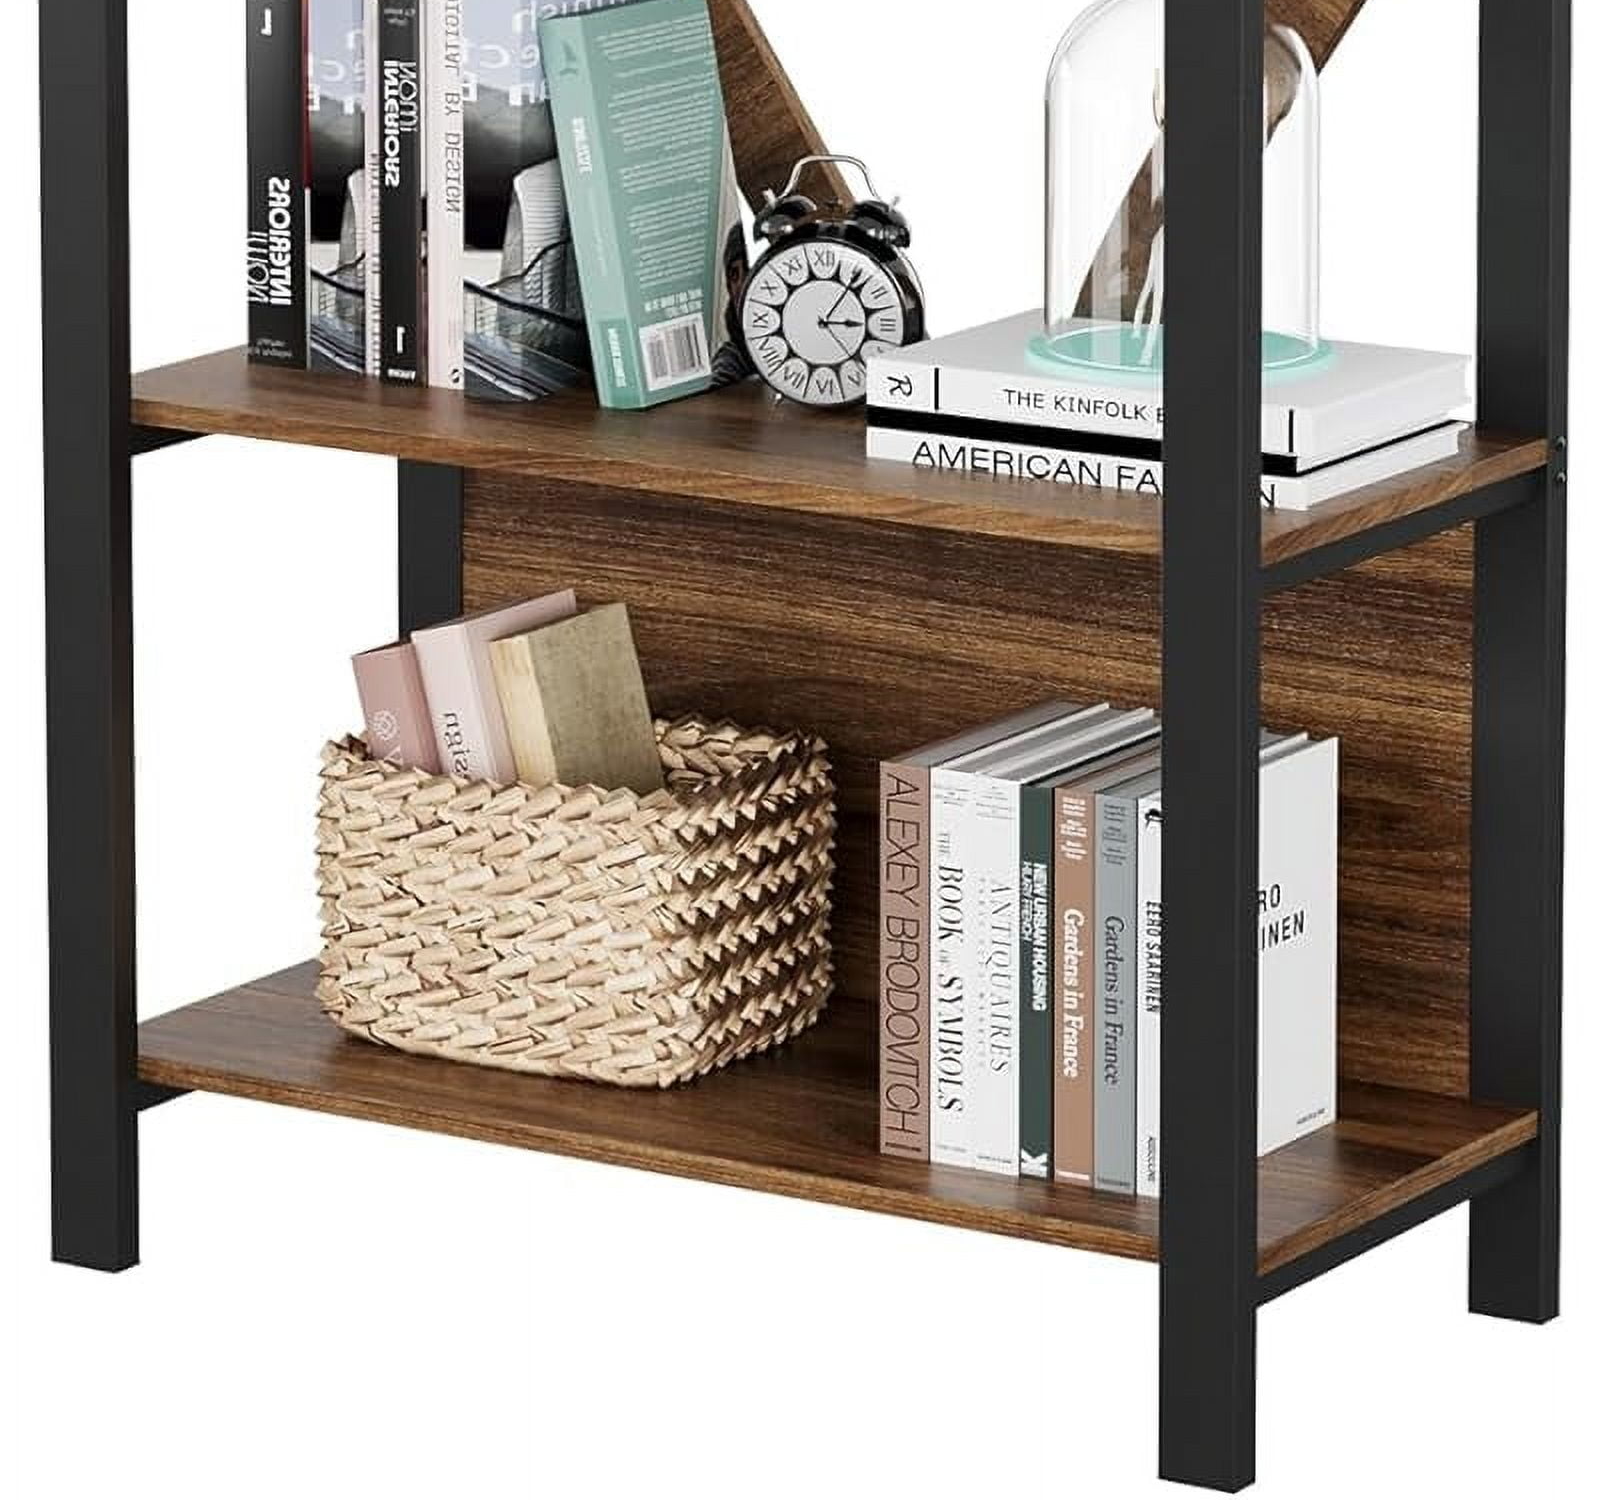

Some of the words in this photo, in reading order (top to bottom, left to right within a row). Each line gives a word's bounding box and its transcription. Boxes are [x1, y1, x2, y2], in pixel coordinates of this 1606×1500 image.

[783, 258, 803, 276] XI
[814, 250, 836, 268] XII
[760, 280, 778, 297] X
[870, 285, 888, 300] II
[752, 311, 770, 329] IX
[879, 317, 897, 333] III
[759, 338, 783, 377] VIII
[783, 368, 806, 390] VII
[816, 378, 834, 396] VI
[1003, 388, 1045, 411] THE
[1052, 395, 1150, 423] KINFOLK
[911, 440, 1103, 488] AMERICAN
[885, 772, 922, 908] ALEXEY
[1033, 862, 1049, 897] NEW
[936, 865, 965, 943] BOOK
[1033, 897, 1049, 948] URBAN
[1146, 899, 1162, 940] EERO
[1062, 908, 1087, 988] Gardens
[1103, 914, 1127, 992] Gardens
[984, 882, 1016, 1076] ANTIQUAIRES
[1033, 948, 1050, 1012] HOUSING
[1146, 941, 1162, 1013] SAARINEN
[1062, 991, 1085, 1010] in
[1103, 996, 1126, 1015] in
[884, 915, 922, 1133] BRODOVITCH
[936, 974, 965, 1113] SYMBOLS
[1062, 1013, 1087, 1078] France
[1103, 1020, 1127, 1086] France
